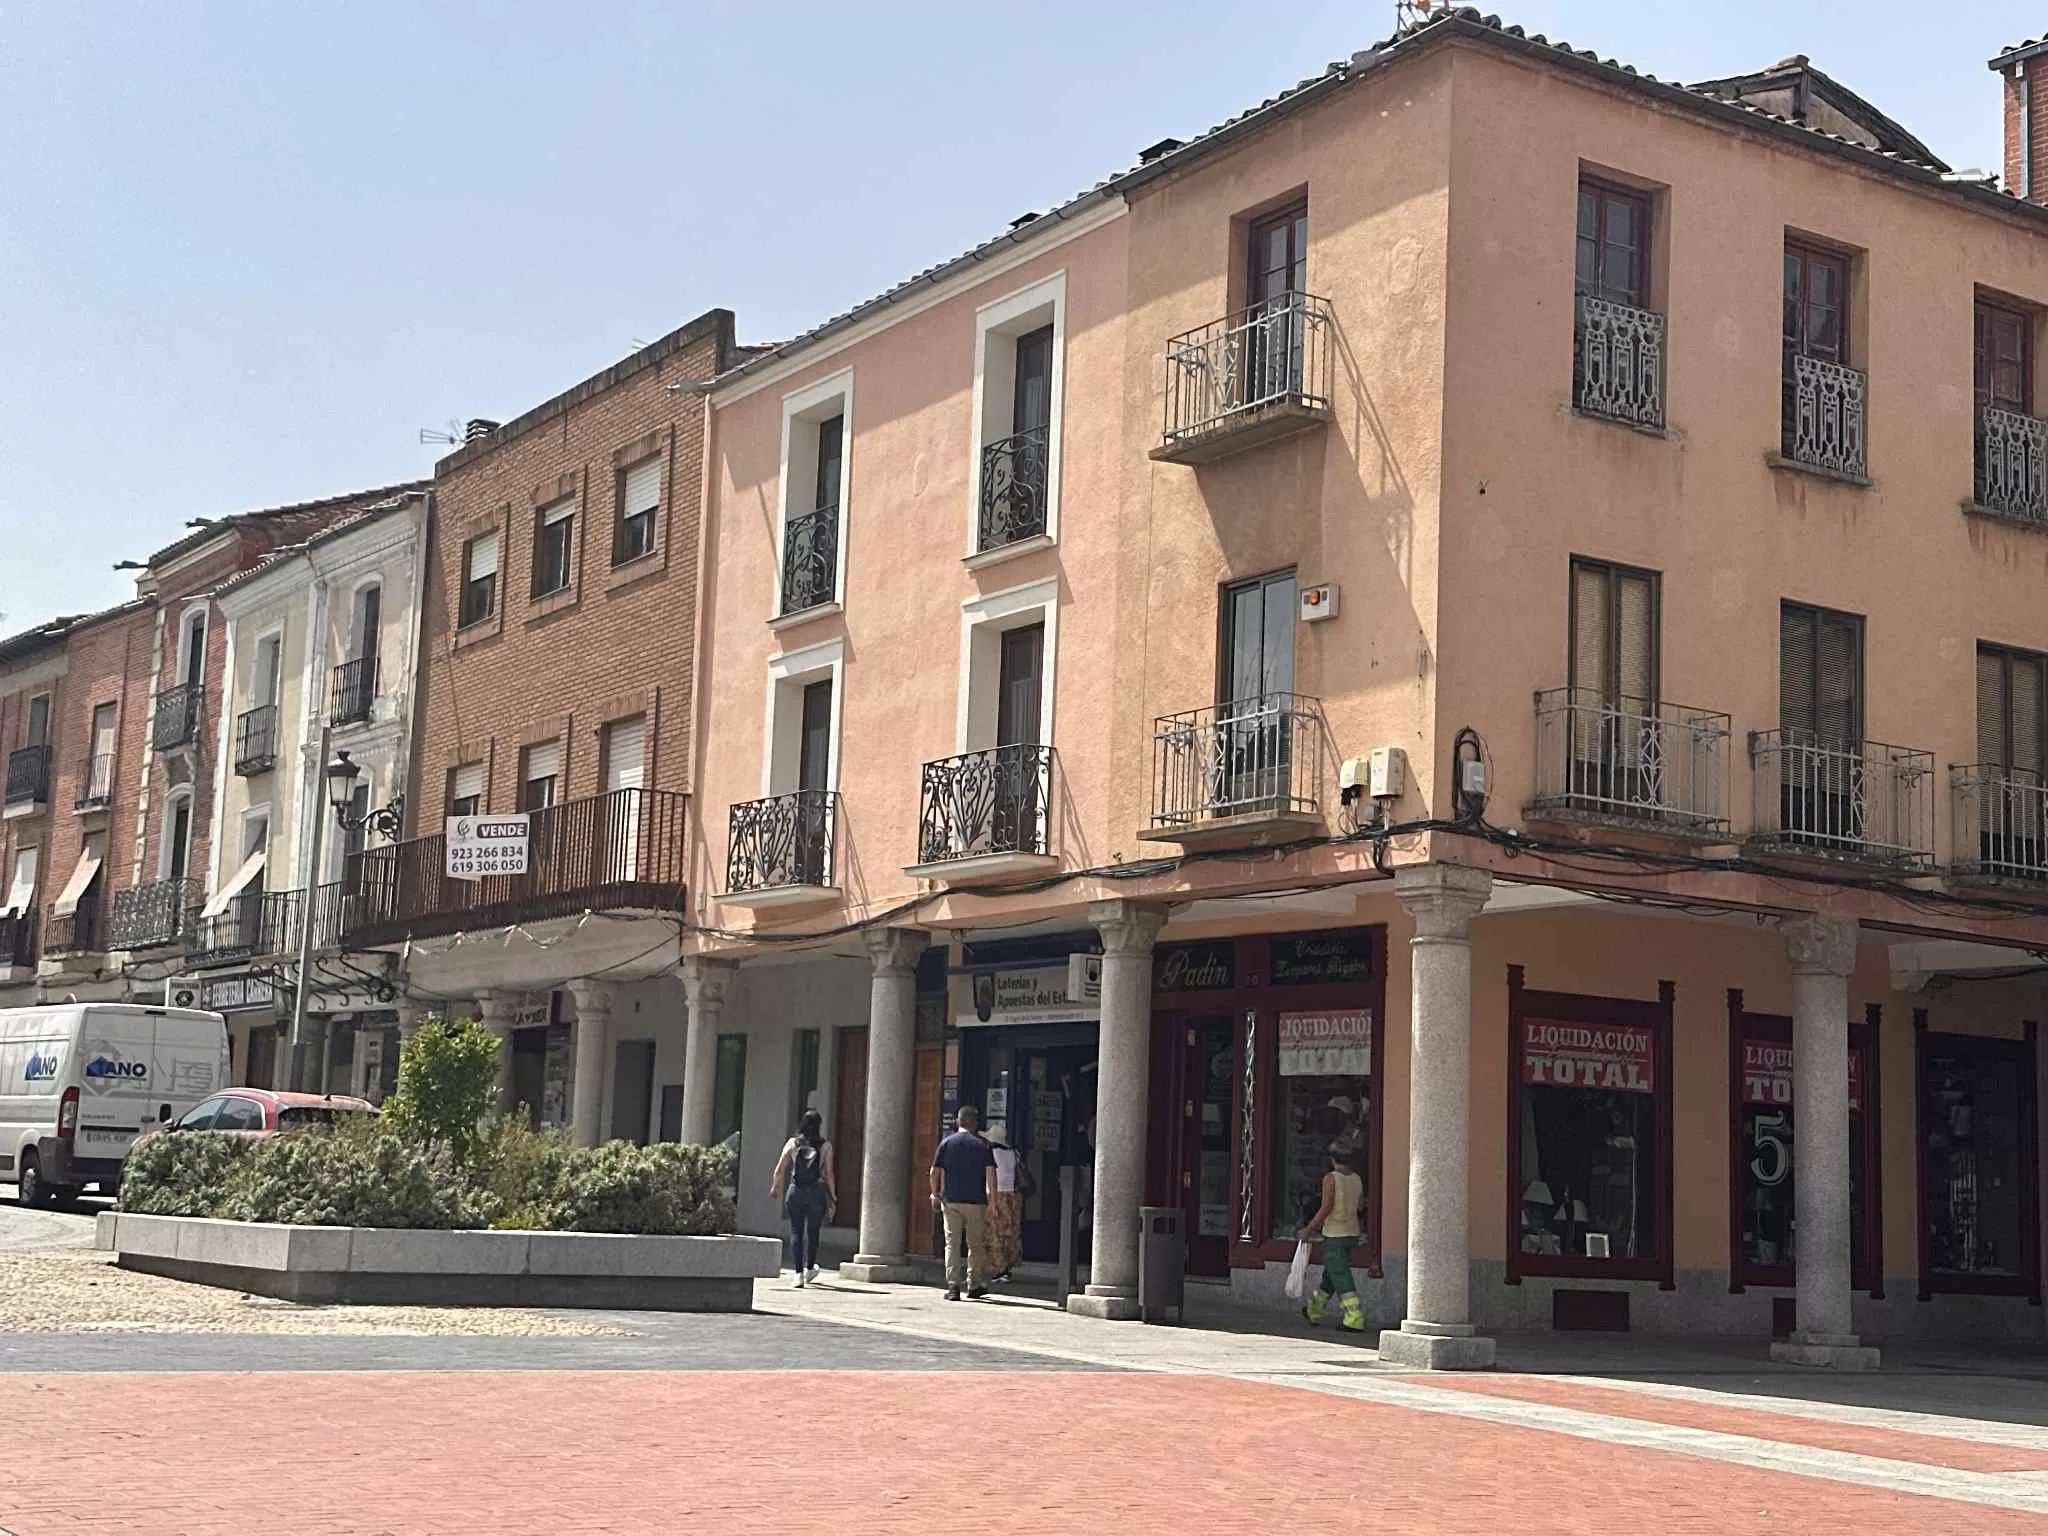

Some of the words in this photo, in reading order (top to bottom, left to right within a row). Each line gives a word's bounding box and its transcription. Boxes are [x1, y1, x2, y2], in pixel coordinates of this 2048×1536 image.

[481, 824, 525, 837] VENDE
[451, 848, 473, 859] 923
[476, 847, 498, 858] 266
[501, 846, 523, 857] 834
[451, 862, 473, 872] 619
[476, 860, 498, 872] 306
[501, 860, 523, 871] 050
[1037, 991, 1051, 1005] del
[1527, 1024, 1649, 1053] LIQUIDACIÓN
[1526, 1055, 1649, 1090] TOTAL
